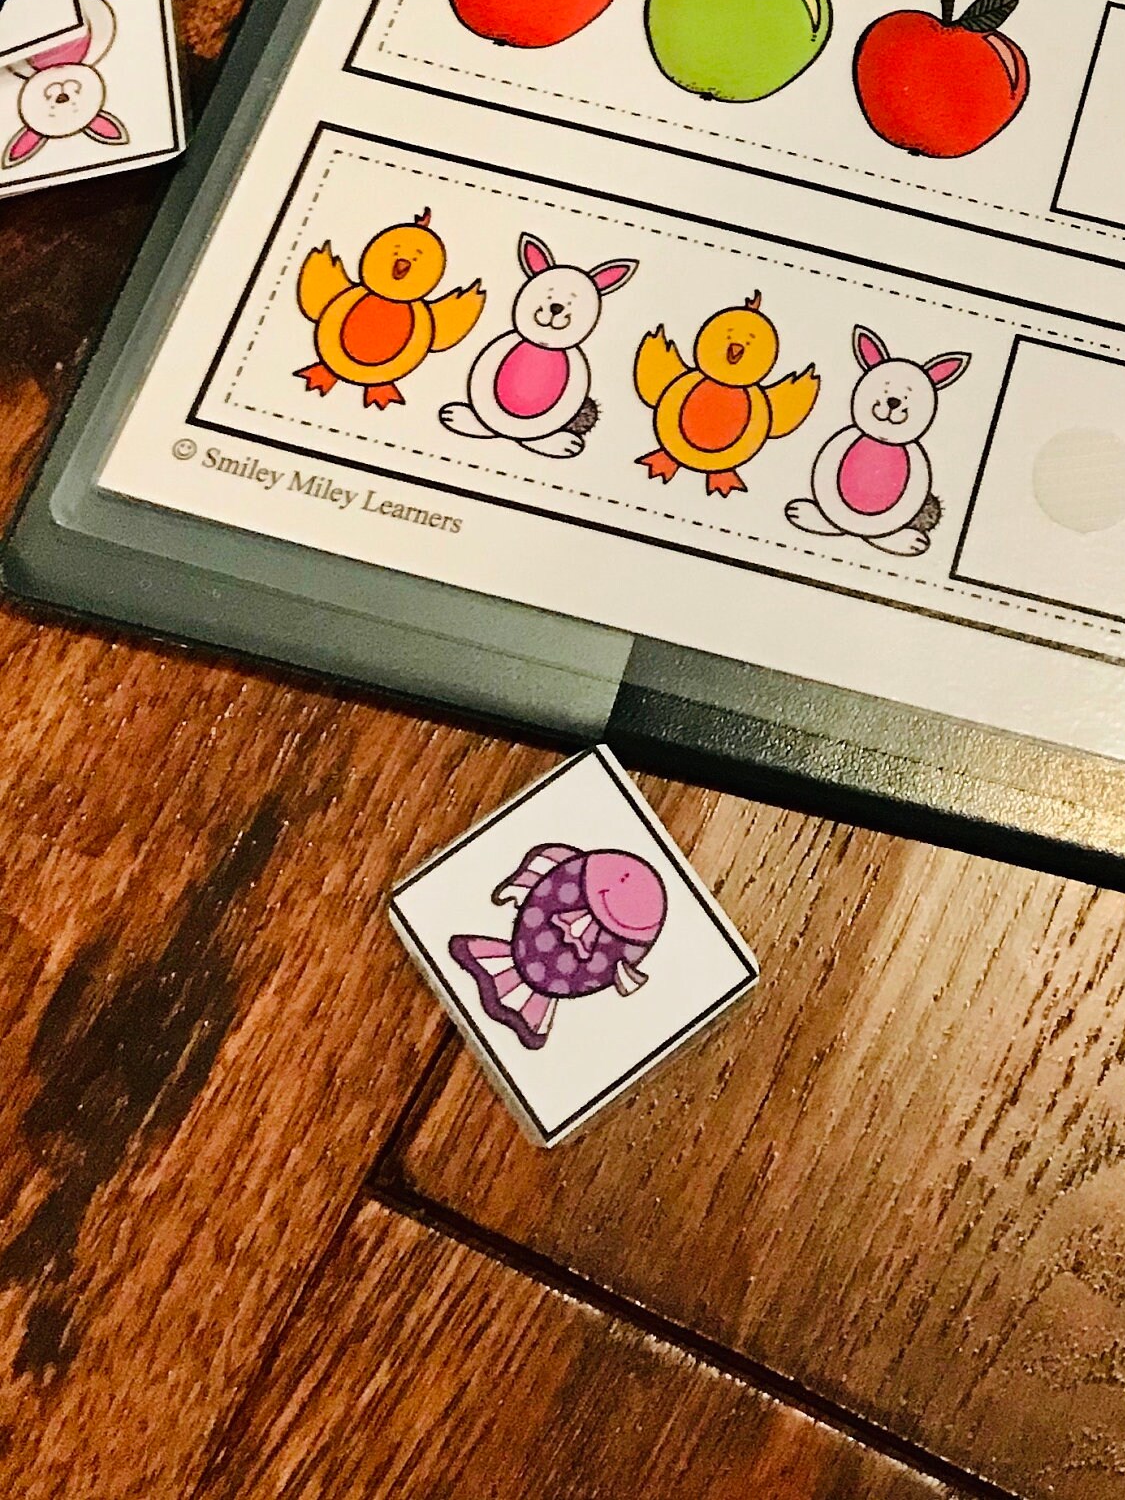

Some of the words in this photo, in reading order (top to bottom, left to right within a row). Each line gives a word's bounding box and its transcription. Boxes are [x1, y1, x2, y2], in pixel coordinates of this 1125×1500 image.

[201, 446, 286, 491] Smiley
[286, 469, 359, 510] Miley
[360, 489, 464, 534] Learners
